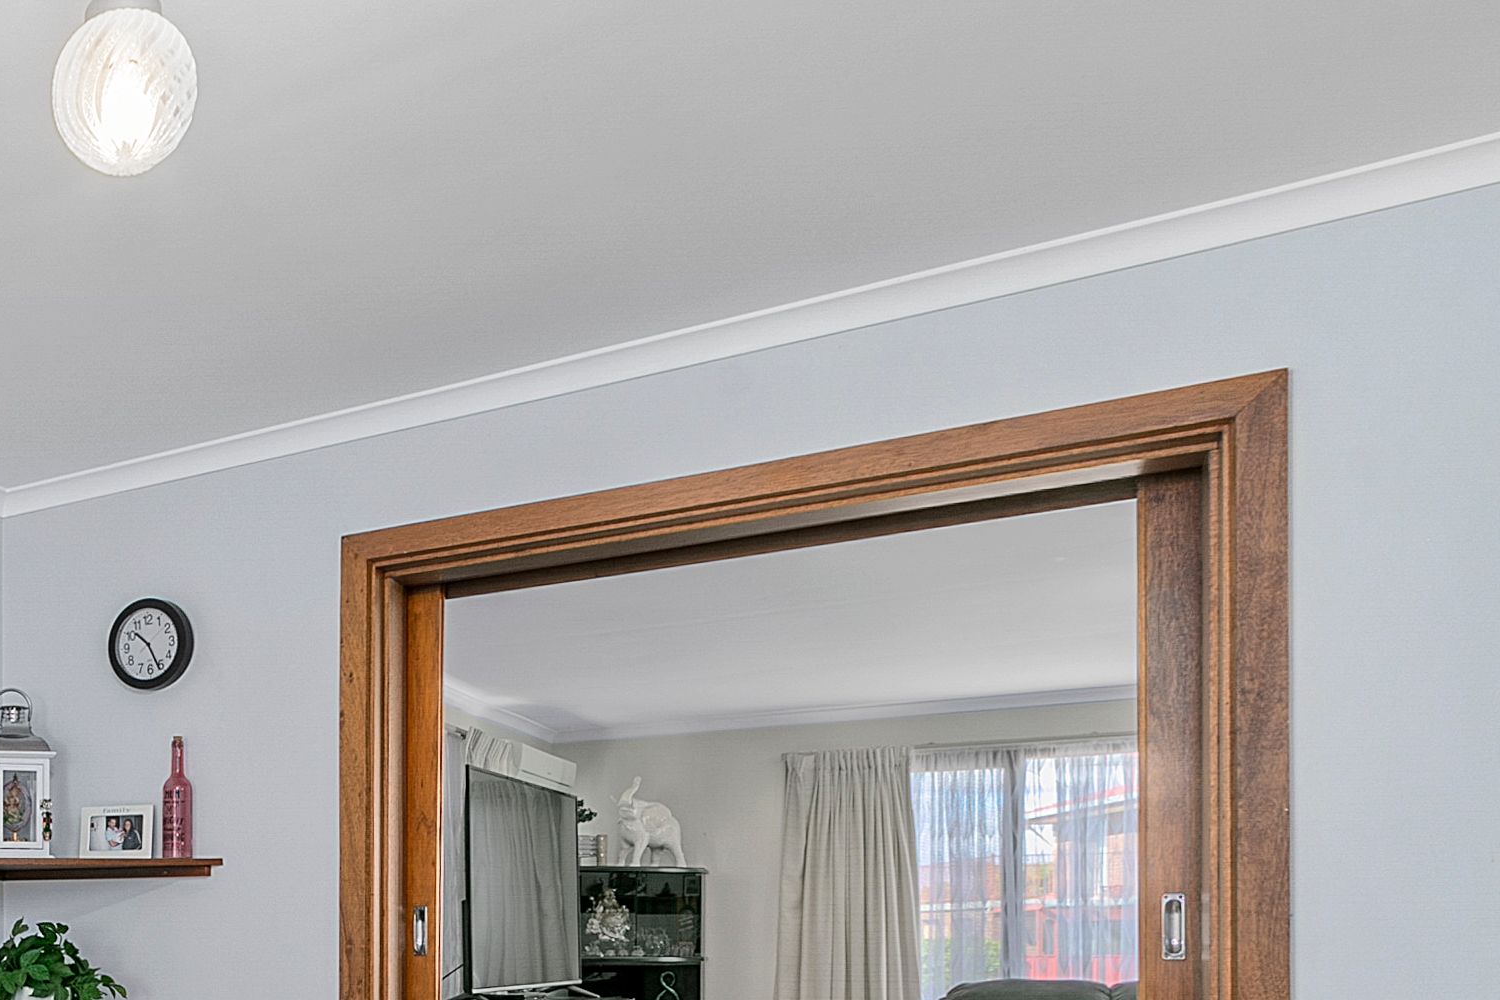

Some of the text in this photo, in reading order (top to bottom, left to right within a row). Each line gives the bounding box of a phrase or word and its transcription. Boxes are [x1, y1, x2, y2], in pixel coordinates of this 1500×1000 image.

[134, 620, 141, 630] 11
[143, 614, 153, 625] 12
[157, 616, 161, 627] 1
[164, 623, 171, 634] 2
[126, 630, 136, 641] 10
[168, 635, 175, 647] 3
[123, 643, 130, 654] 9
[165, 650, 171, 658] 4
[128, 655, 134, 666] 8
[138, 663, 143, 673] 7
[147, 664, 154, 675] 6
